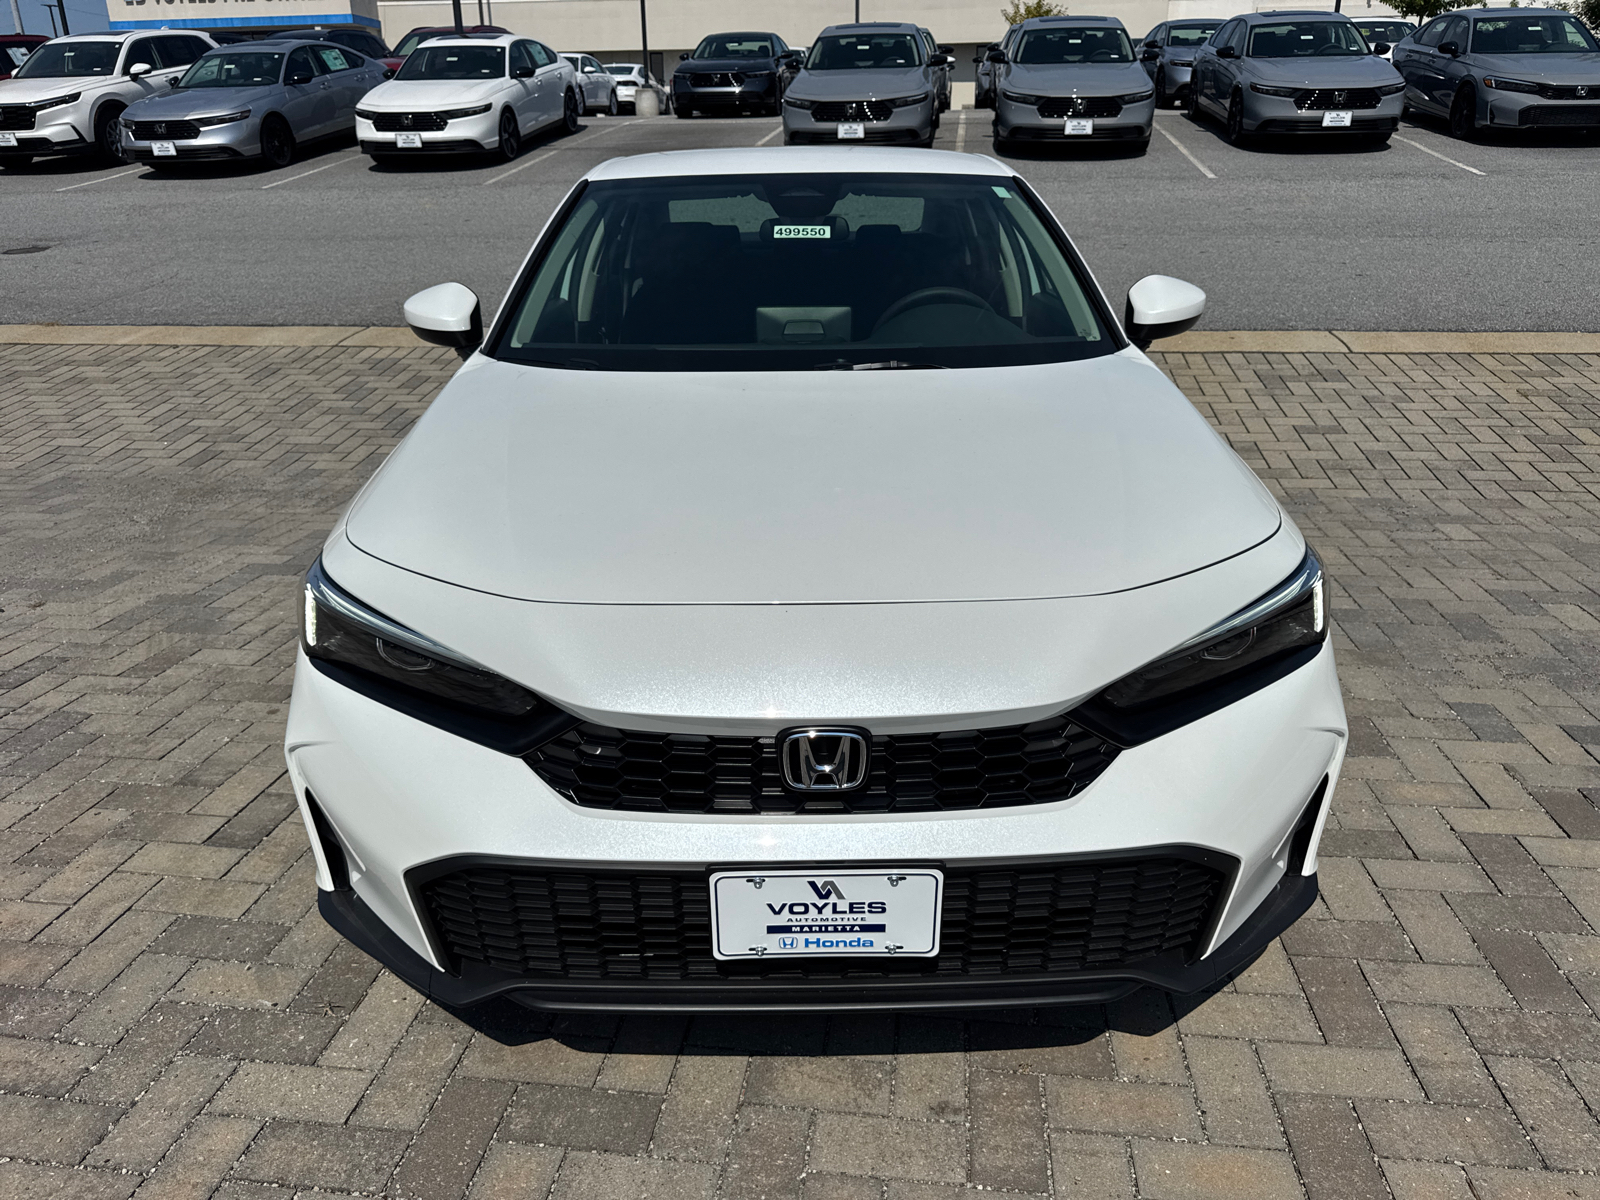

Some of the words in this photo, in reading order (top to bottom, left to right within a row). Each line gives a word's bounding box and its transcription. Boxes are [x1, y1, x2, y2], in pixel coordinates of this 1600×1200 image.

[775, 227, 826, 236] 499550
[766, 901, 887, 915] VOYLES
[804, 937, 874, 948] Honda
